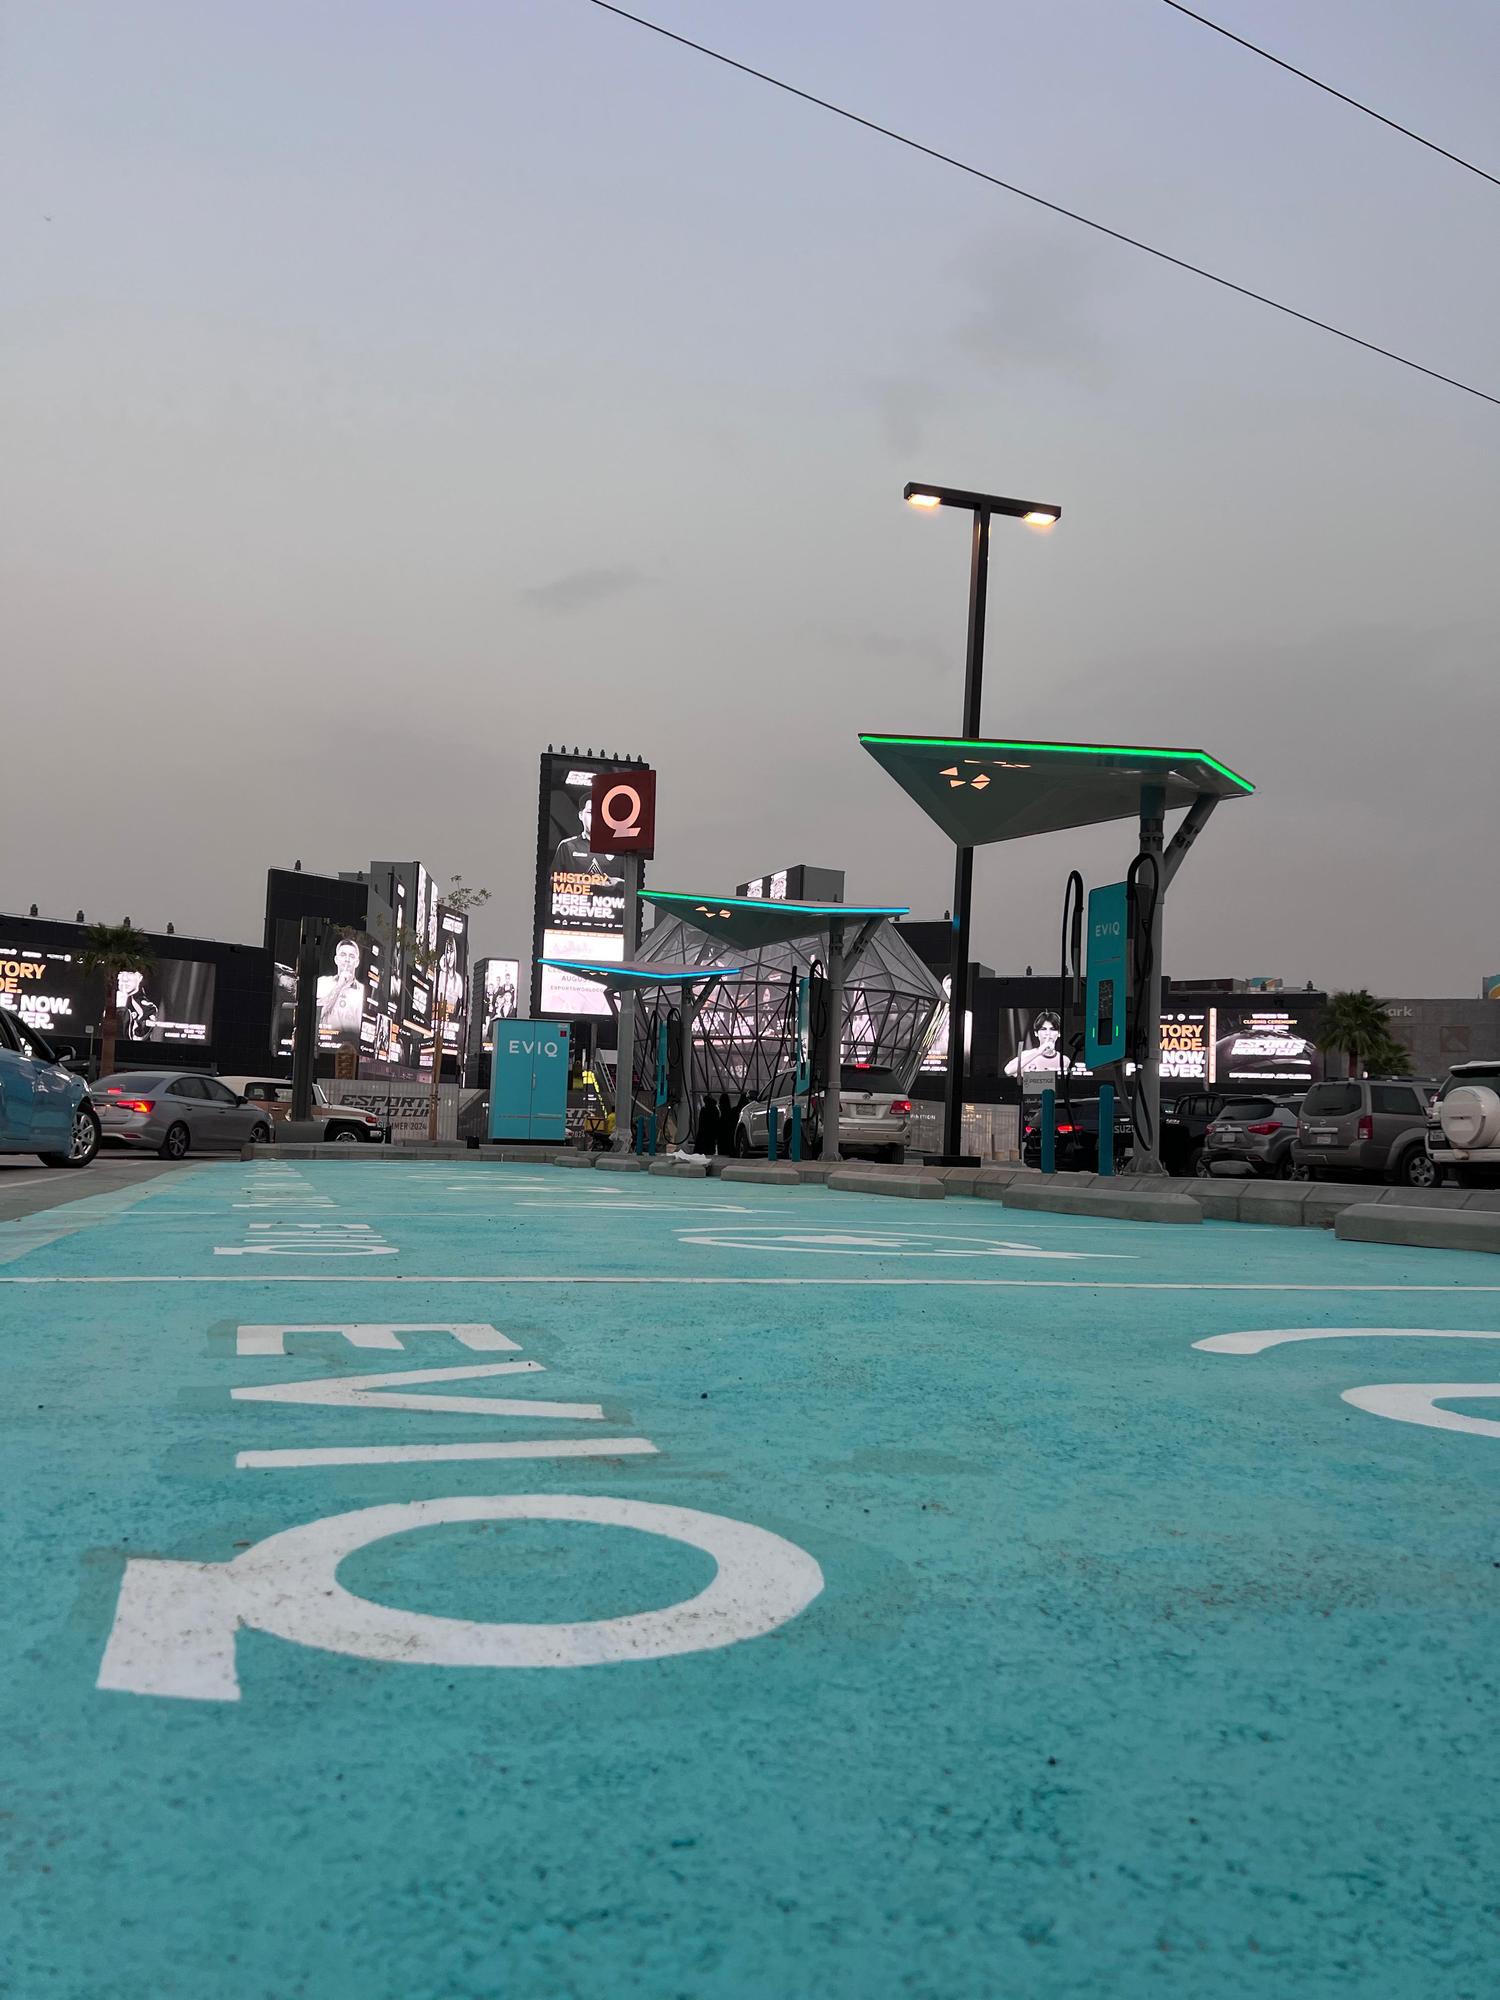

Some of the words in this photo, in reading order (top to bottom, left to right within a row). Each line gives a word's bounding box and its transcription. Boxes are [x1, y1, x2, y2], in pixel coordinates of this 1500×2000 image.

[601, 784, 641, 838] Q
[553, 883, 594, 896] MADE.
[552, 893, 591, 906] HERE.
[592, 896, 625, 909] NOW.
[551, 904, 615, 919] FOREVER.
[1095, 921, 1120, 937] EVIQ
[20, 994, 73, 1015] NOW.
[1385, 1005, 1414, 1018] ark
[509, 1040, 558, 1057] EVIQ
[1162, 1050, 1206, 1065] NOW.
[96, 1323, 825, 1701] EVIQ
